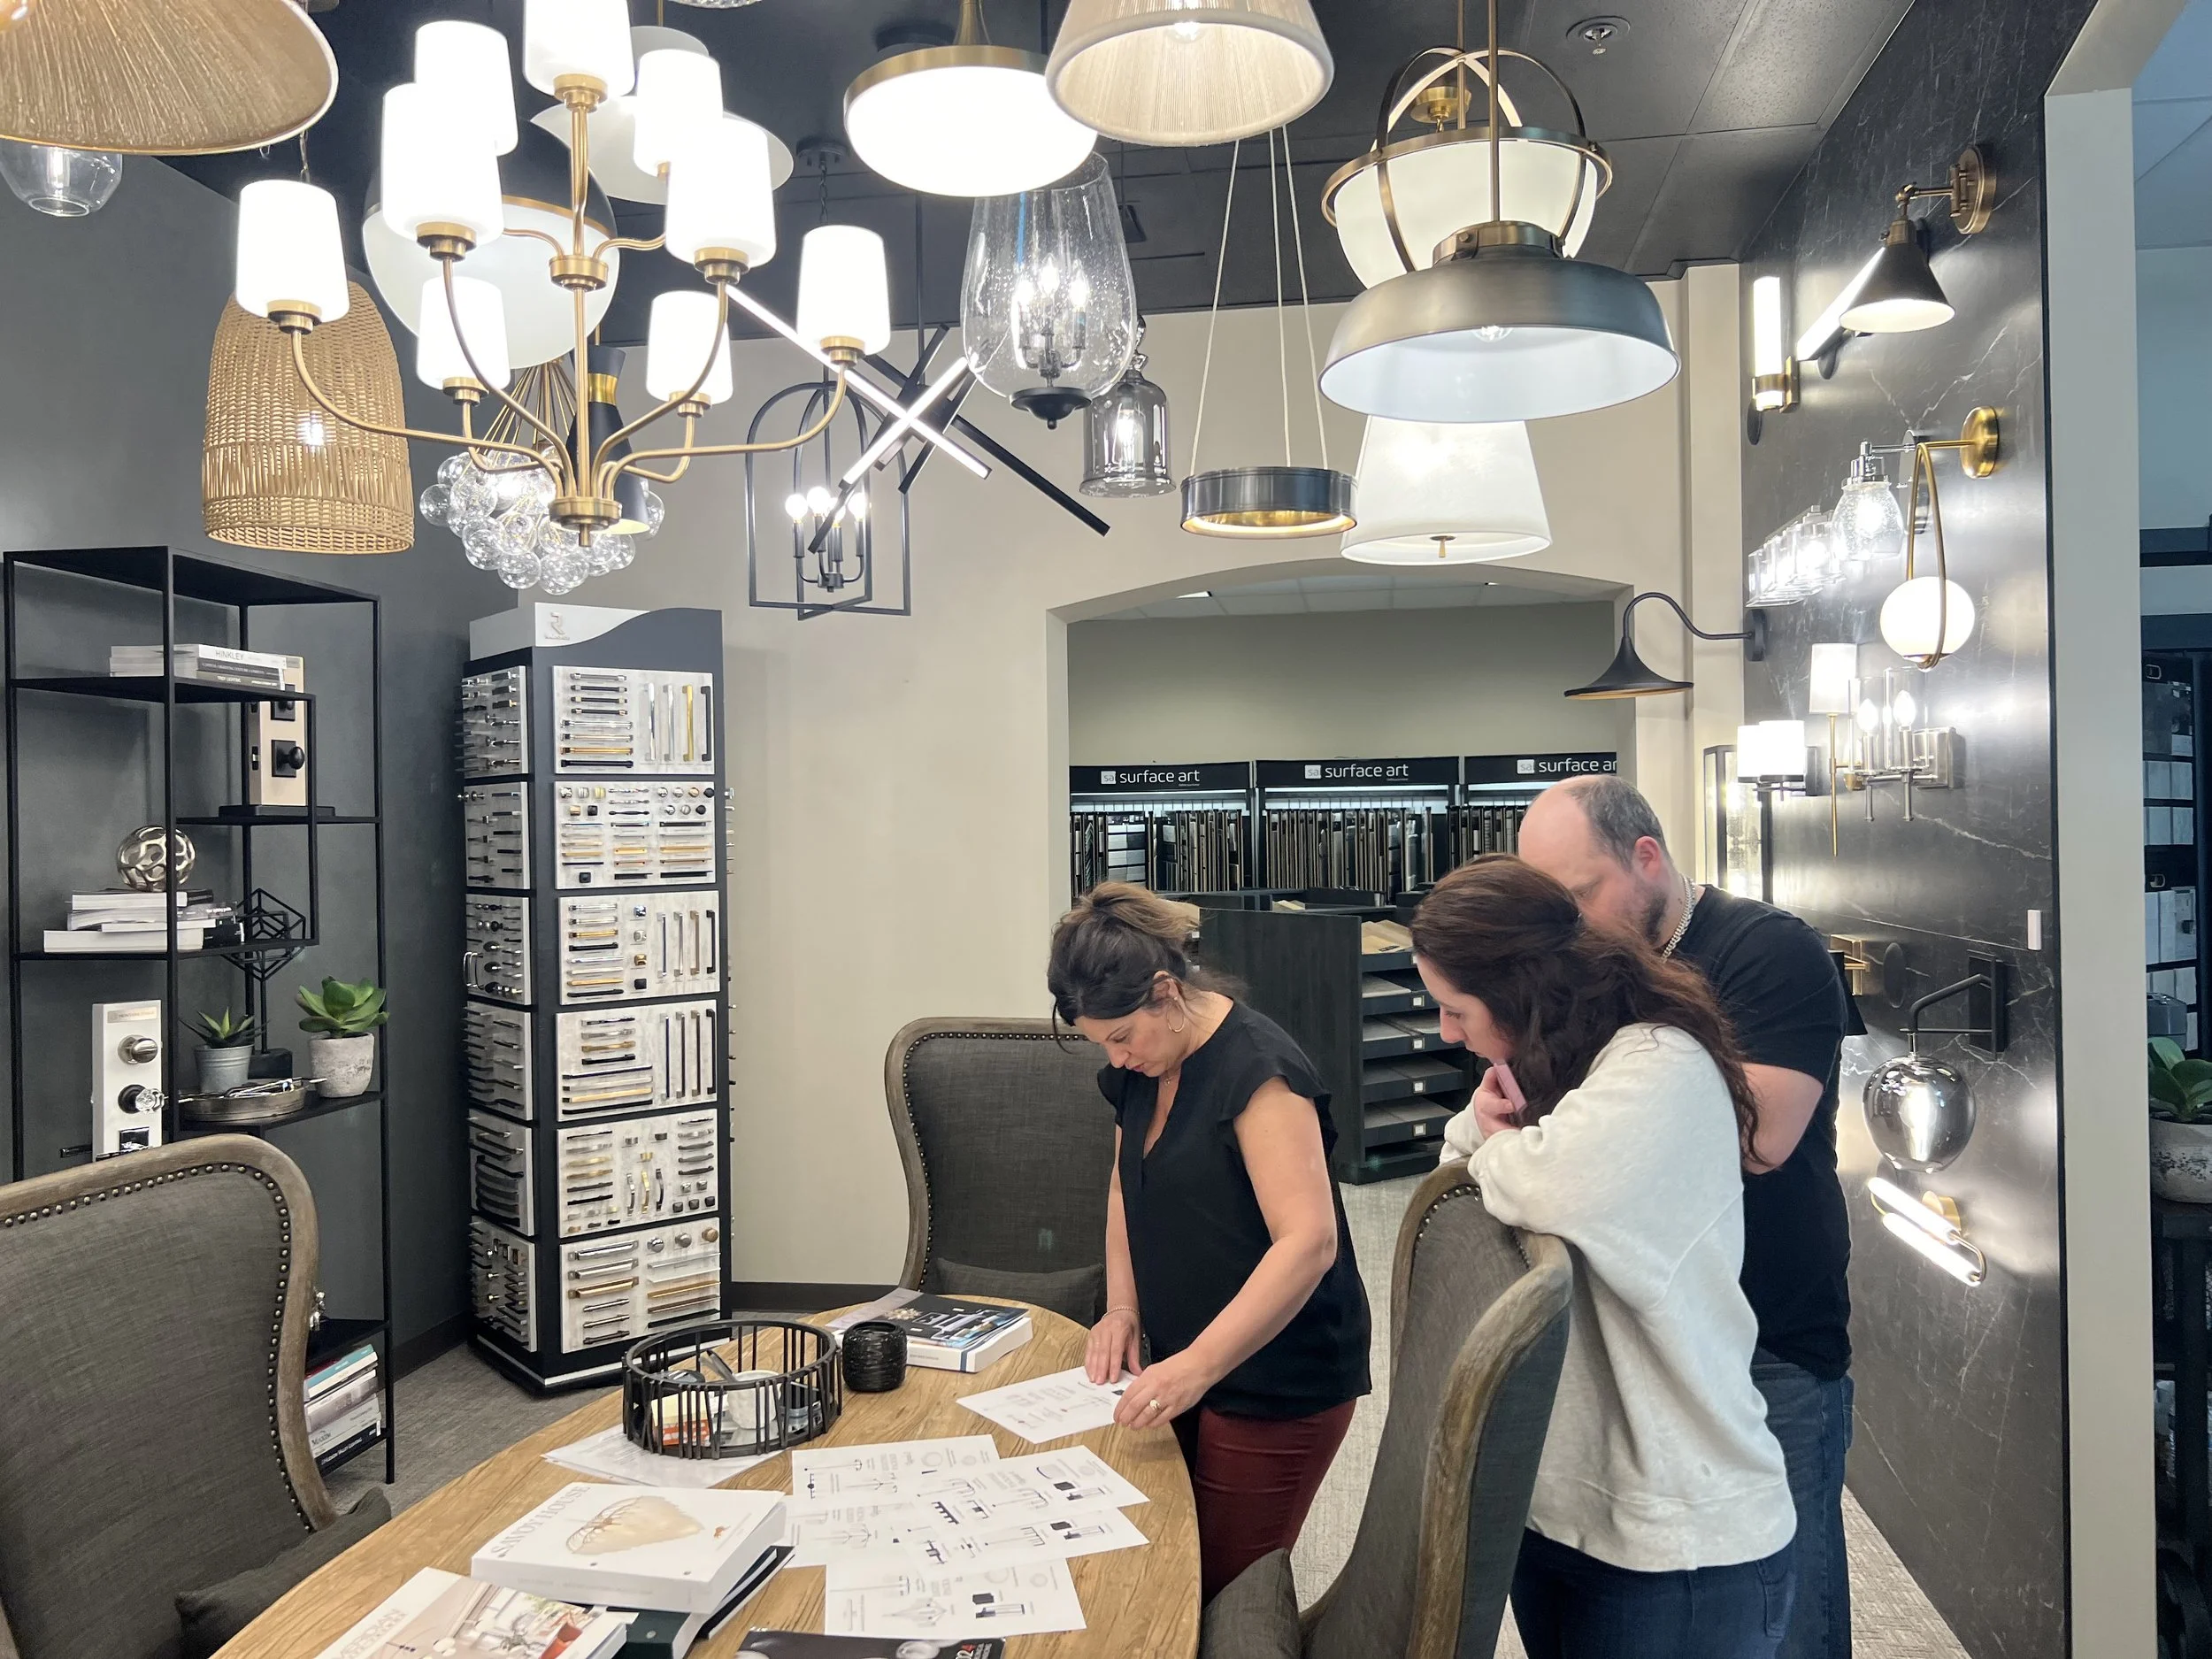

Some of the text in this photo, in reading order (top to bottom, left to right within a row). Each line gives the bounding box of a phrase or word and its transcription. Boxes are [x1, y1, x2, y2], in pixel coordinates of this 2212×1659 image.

[215, 650, 243, 661] HINKLEY
[1325, 764, 1382, 778] surface
[1386, 764, 1409, 777] art
[1538, 758, 1599, 772] surface
[1602, 760, 1617, 772] ar
[1119, 770, 1174, 783] surface
[1178, 770, 1201, 782] art
[491, 1486, 591, 1558] SAVOY HOUSE
